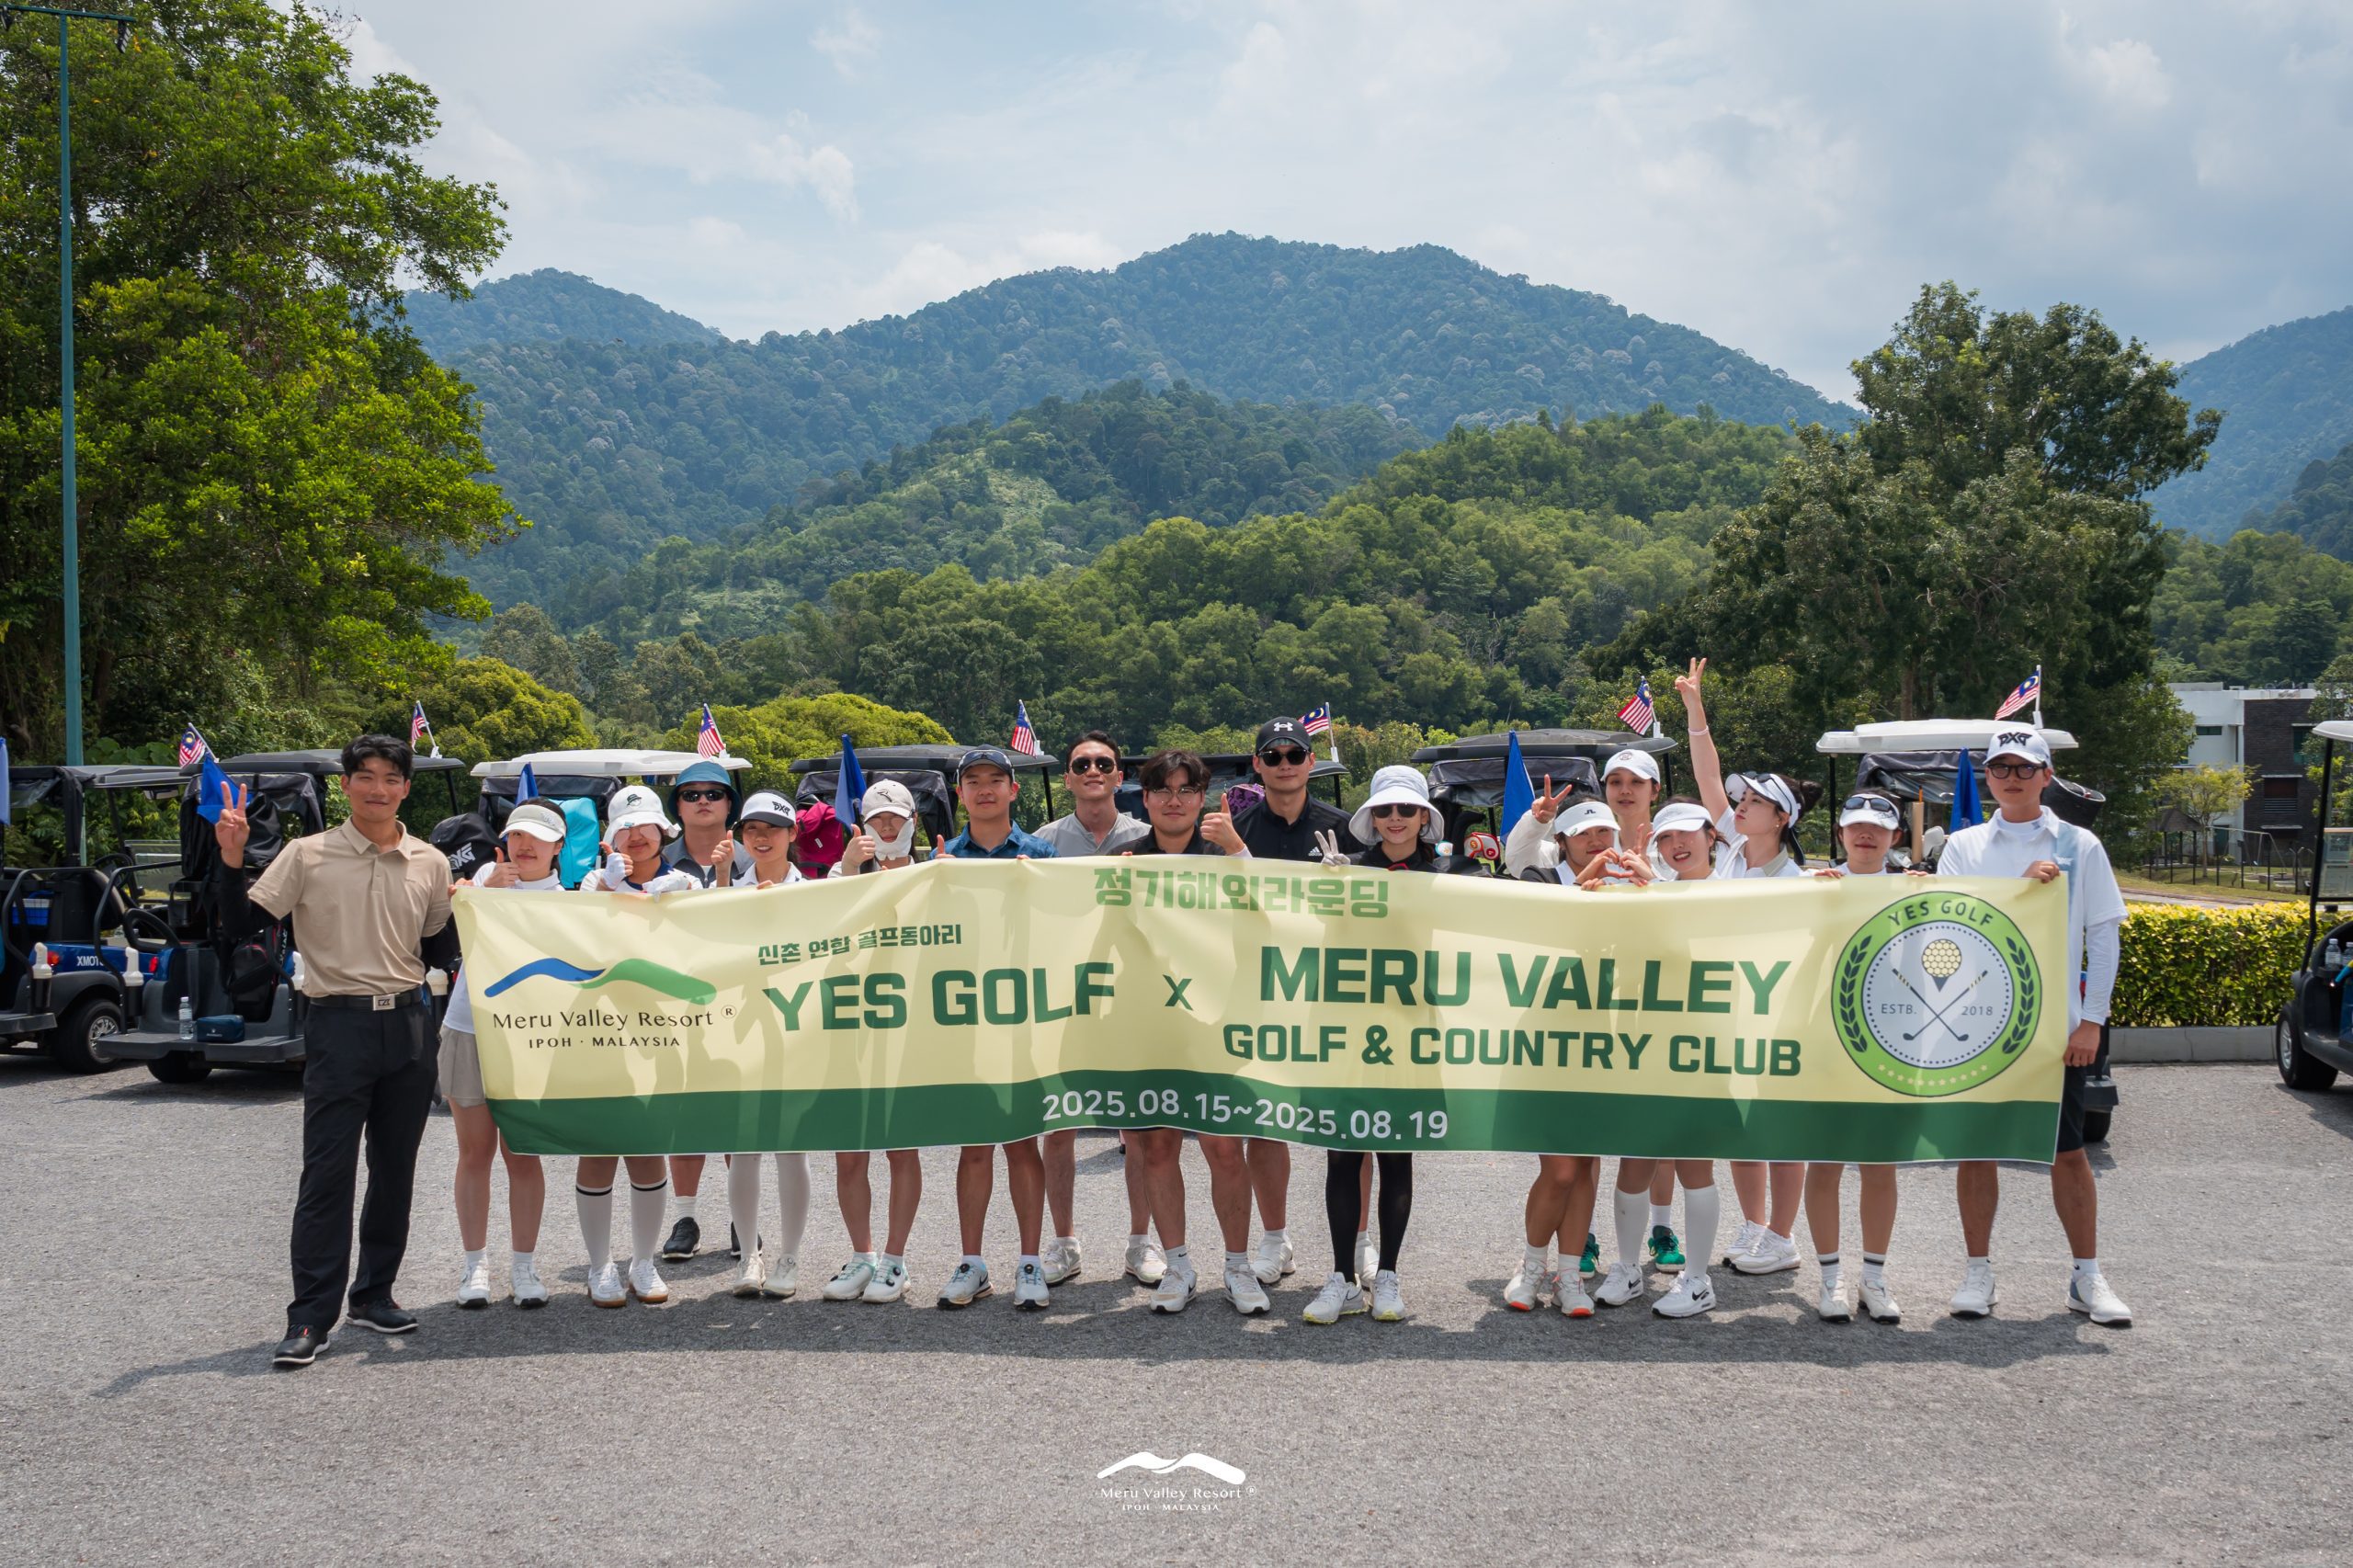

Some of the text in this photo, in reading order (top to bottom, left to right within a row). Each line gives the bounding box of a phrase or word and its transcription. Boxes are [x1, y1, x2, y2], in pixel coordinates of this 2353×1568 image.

[1094, 868, 1389, 919] 정기해외라운딩
[1887, 900, 1994, 926] YES GOLF
[757, 924, 962, 965] 신촌 연합 골프동아리
[76, 955, 105, 967] XMOT
[761, 971, 908, 1032] YES
[931, 961, 1115, 1027] GOLF
[1260, 946, 1472, 1007] MERU
[1496, 952, 1792, 1016] VALLEY
[493, 1013, 552, 1029] Meru
[560, 1009, 629, 1031] Valley
[639, 1010, 714, 1028] Resort
[1881, 1003, 1917, 1015] ESTB.
[1961, 1006, 1994, 1017] 2018
[529, 1036, 680, 1049] IPOH MALAYSIA
[1222, 1023, 1802, 1076] GOLF & COUNTRY CLUB
